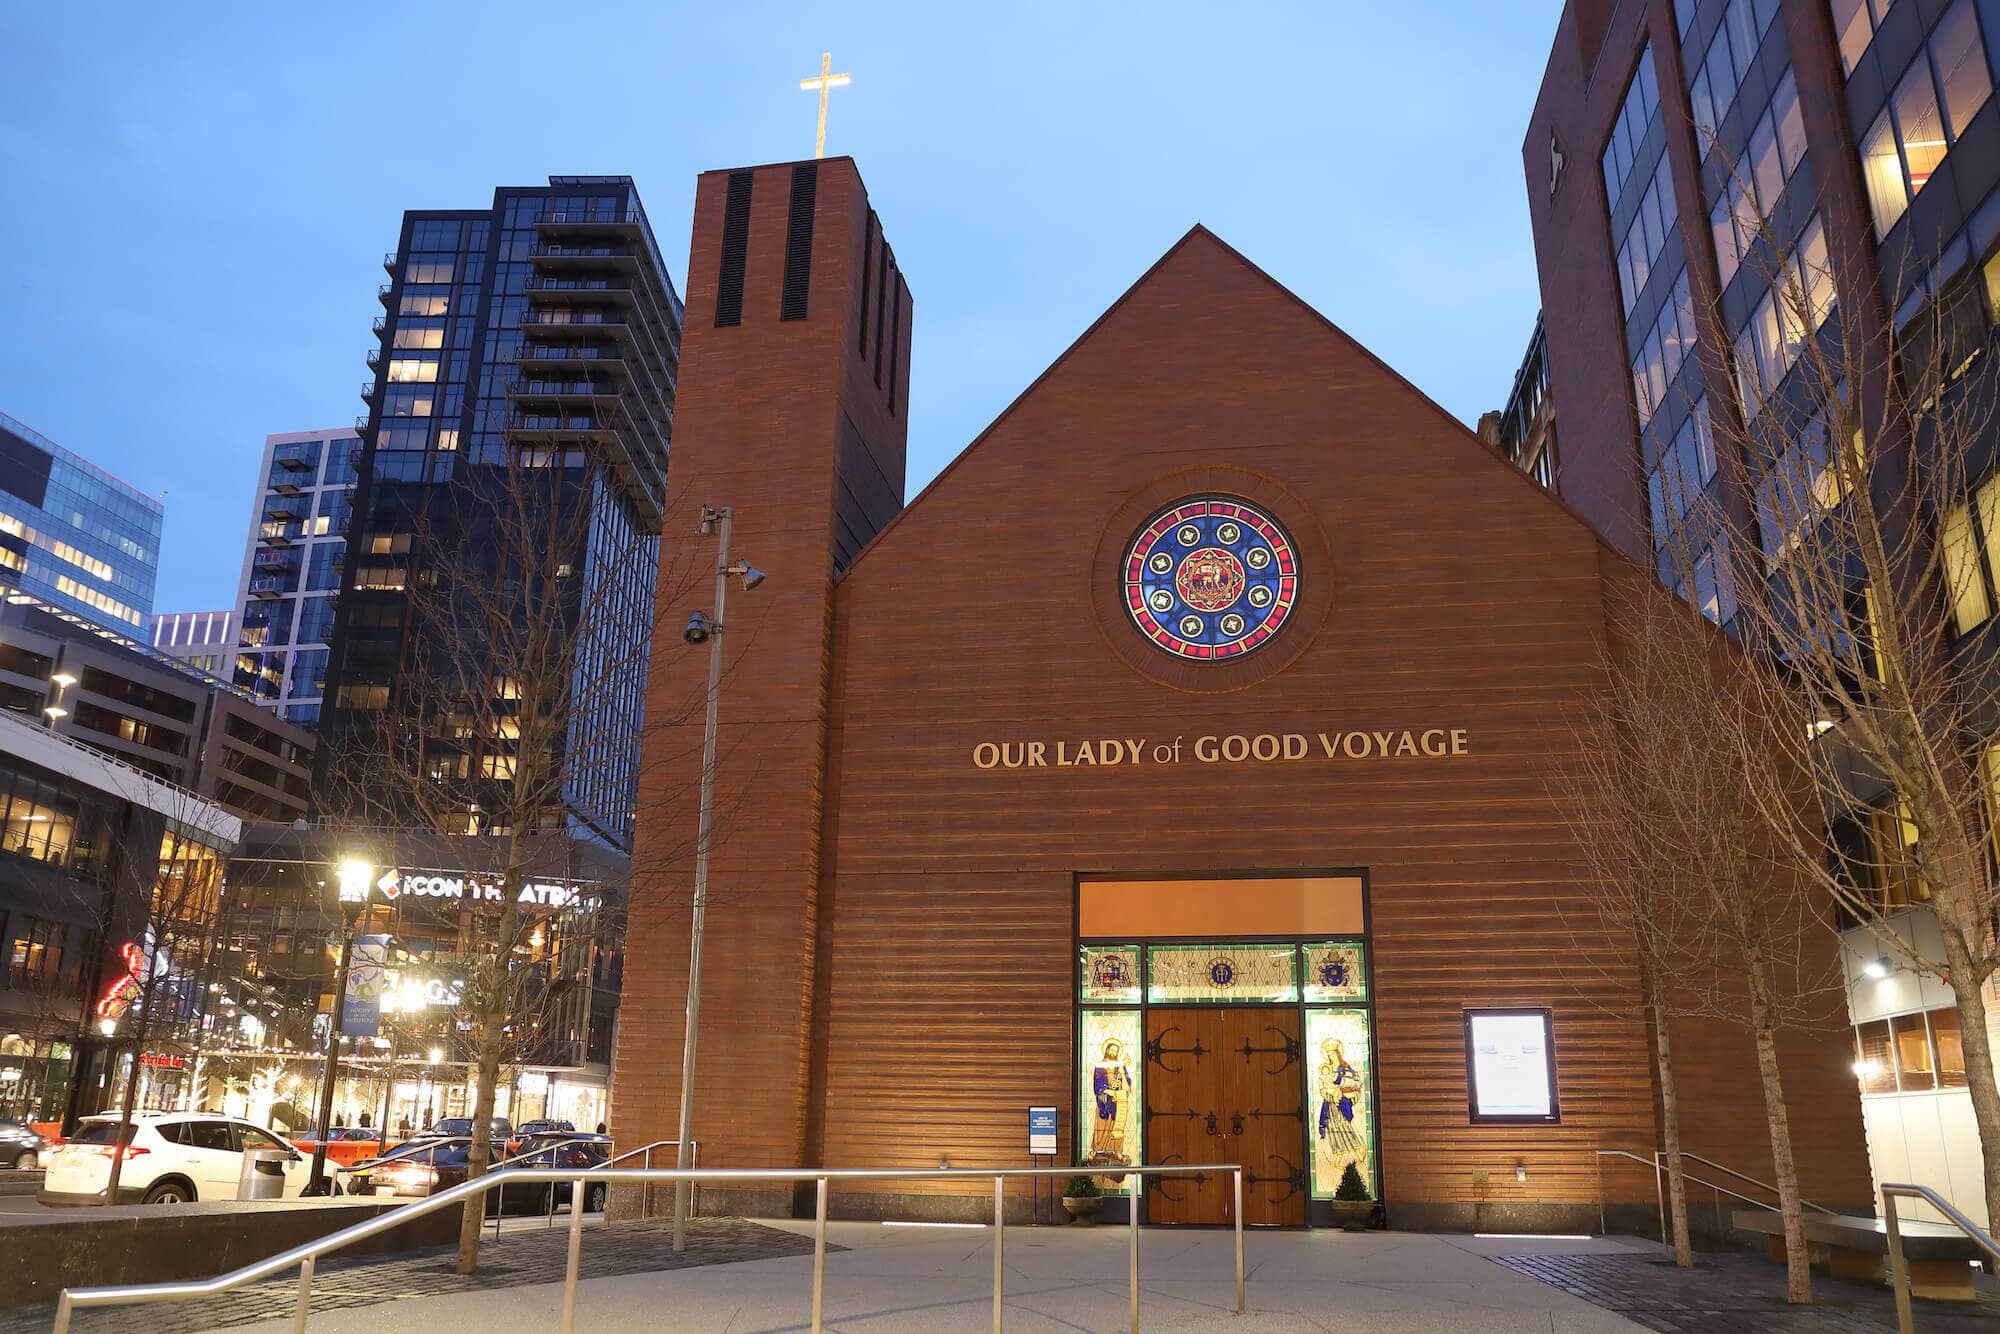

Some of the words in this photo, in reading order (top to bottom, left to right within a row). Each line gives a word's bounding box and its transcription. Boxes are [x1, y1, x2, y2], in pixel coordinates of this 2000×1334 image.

[973, 742, 1047, 769] OUR
[1057, 738, 1146, 767] LADY
[1153, 735, 1183, 764] of
[1193, 734, 1308, 763] GOOD
[1318, 728, 1470, 759] VOYAGE
